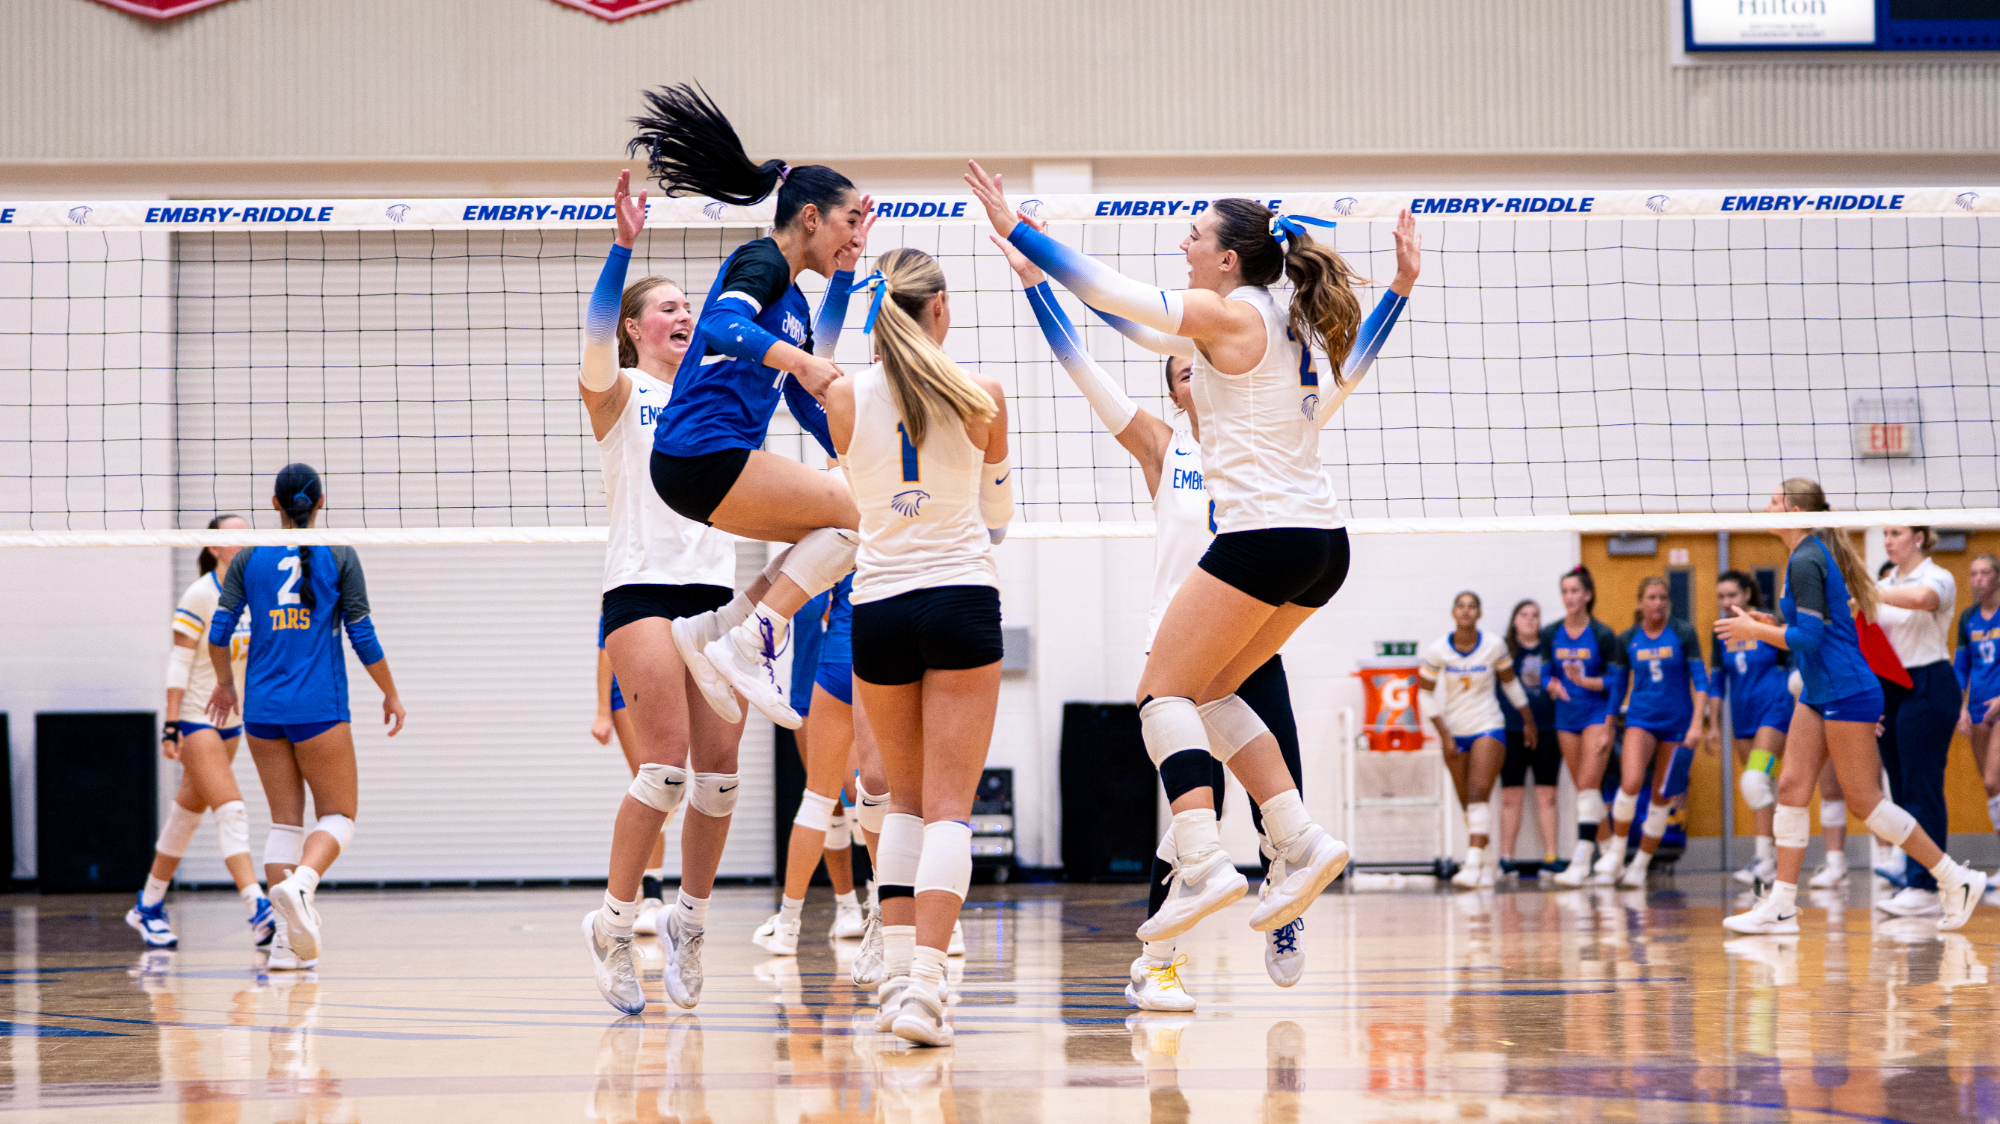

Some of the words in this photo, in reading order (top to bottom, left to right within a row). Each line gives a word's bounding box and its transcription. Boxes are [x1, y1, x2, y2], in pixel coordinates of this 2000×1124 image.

[869, 202, 968, 218] -RIDDLE
[1094, 200, 1282, 217] EMBRY-RE
[1411, 197, 1595, 214] EMBRY-RIDDLE
[1720, 194, 1905, 212] EMBRY-RIDDLE
[145, 207, 334, 223] EMBRY-RIDDLE
[462, 205, 651, 221] EMBRY-RIDD
[895, 420, 922, 484] 1
[277, 555, 303, 606] 2
[268, 607, 311, 631] TARS
[1382, 678, 1410, 710] G
